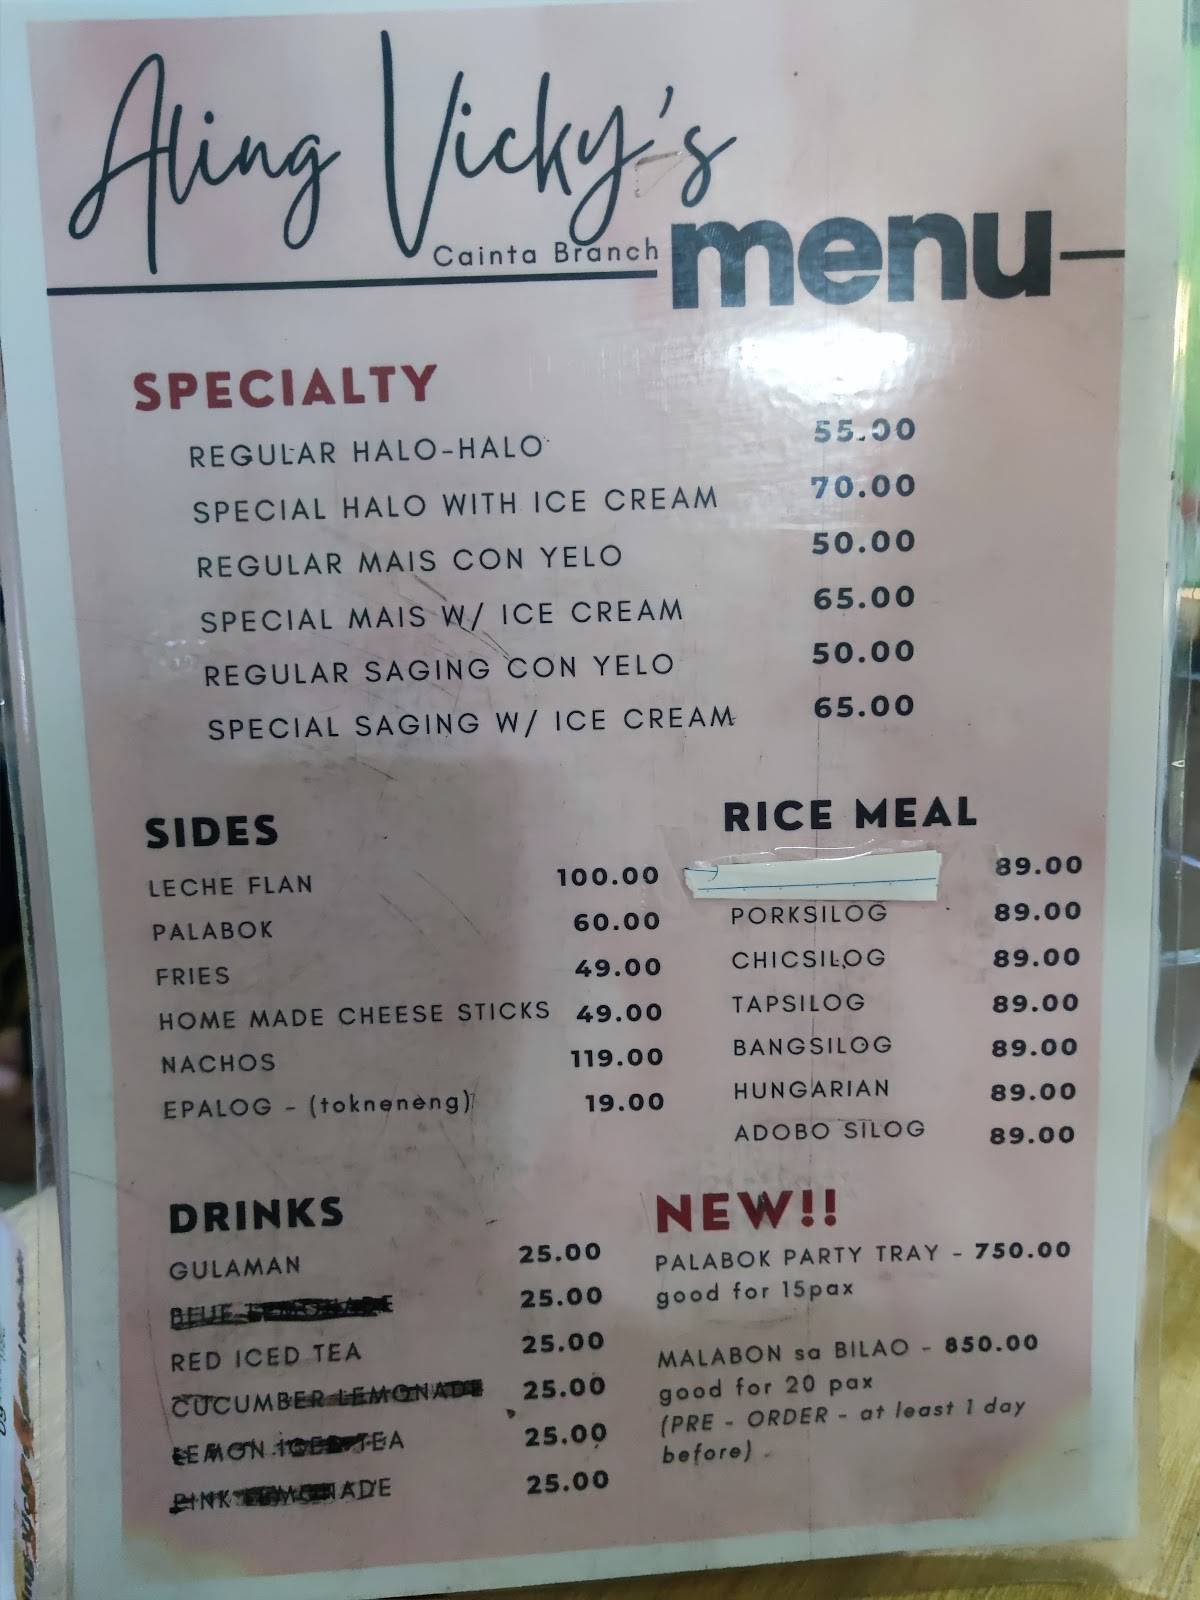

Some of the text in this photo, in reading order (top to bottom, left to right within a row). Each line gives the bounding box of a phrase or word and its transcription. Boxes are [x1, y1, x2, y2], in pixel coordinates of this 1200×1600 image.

[68, 29, 737, 275] Aling Vicky's
[432, 237, 660, 268] Cainta Branch
[671, 210, 1052, 309] menu
[133, 363, 438, 412] SPECIALTY
[814, 417, 916, 443] 55.00
[189, 434, 543, 469] REGULAR HALO-HALO
[811, 473, 916, 499] 70.00
[193, 485, 718, 524] SPECIAL HALO WITH ICE CREAM
[811, 529, 916, 555] 50.00
[197, 544, 622, 579] REGULAR MAIS CON YELO
[813, 585, 915, 611] 65.00
[200, 598, 683, 634] SPECIAL MAIS W/ ICE CREAM
[812, 639, 915, 665] 50.00
[204, 653, 674, 687] REGULAR SAGING CON YELO
[814, 694, 914, 719] 65.00
[208, 705, 735, 741] SPECIAL SAGING W/ ICE CREAM
[724, 795, 977, 833] RICE MEAL
[145, 814, 279, 850] SIDES
[556, 866, 659, 887] 100.00
[995, 855, 1083, 877] 89.00
[149, 874, 312, 898] LECHE FLAN
[573, 911, 660, 932] 60.00
[731, 903, 887, 925] PORKSILOG
[994, 901, 1082, 922] 89.00
[152, 920, 273, 942] PALABOK
[574, 957, 661, 978] 49.00
[731, 948, 885, 970] CHICSILOG
[993, 947, 1080, 968] 89.00
[156, 966, 230, 987] FRIES
[159, 1000, 550, 1031] HOME MADE CHEESE STICKS
[576, 1002, 662, 1023] 49.00
[731, 993, 865, 1014] TAPSILOG
[992, 993, 1079, 1014] 89.00
[570, 1047, 664, 1068] 119.00
[733, 1035, 892, 1057] BANGSILOG
[991, 1037, 1078, 1058] 89.00
[161, 1053, 276, 1074] NACHOS
[585, 1092, 664, 1113] 19.00
[734, 1079, 889, 1100] HUNGARIAN
[990, 1082, 1077, 1102] 89.00
[163, 1097, 272, 1120] EPALOG
[309, 1089, 475, 1119] (tokneneng)
[734, 1119, 925, 1142] ADOBO SILOG
[989, 1125, 1075, 1145] 89.00
[169, 1195, 344, 1234] DRINKS
[656, 1188, 837, 1234] NEW!!
[518, 1242, 601, 1265] 25.00
[655, 1249, 771, 1273] PALABOK
[784, 1246, 862, 1266] PARTY
[875, 1244, 939, 1263] TRAY
[975, 1241, 1071, 1260] 750.00
[169, 1255, 300, 1281] GULAMAN
[520, 1286, 603, 1309] 25.00
[656, 1282, 719, 1311] good
[732, 1281, 770, 1300] for
[521, 1331, 605, 1355] 25.00
[657, 1344, 781, 1369] MALABON
[794, 1347, 821, 1361] sa
[834, 1338, 909, 1360] BILAO
[945, 1333, 1038, 1354] 850.00
[171, 1341, 362, 1373] RED ICED TEA
[523, 1376, 606, 1401] 25.00
[659, 1374, 873, 1407] good for 20 pax
[171, 1390, 325, 1418] CUCUMBER
[662, 1412, 714, 1438] (PRE
[747, 1406, 828, 1429] ORDER
[860, 1404, 885, 1422] at
[895, 1400, 955, 1419] least
[983, 1396, 1026, 1418] day
[524, 1422, 607, 1449] 25.00
[662, 1440, 752, 1465] before)
[526, 1469, 609, 1495] 25.00
